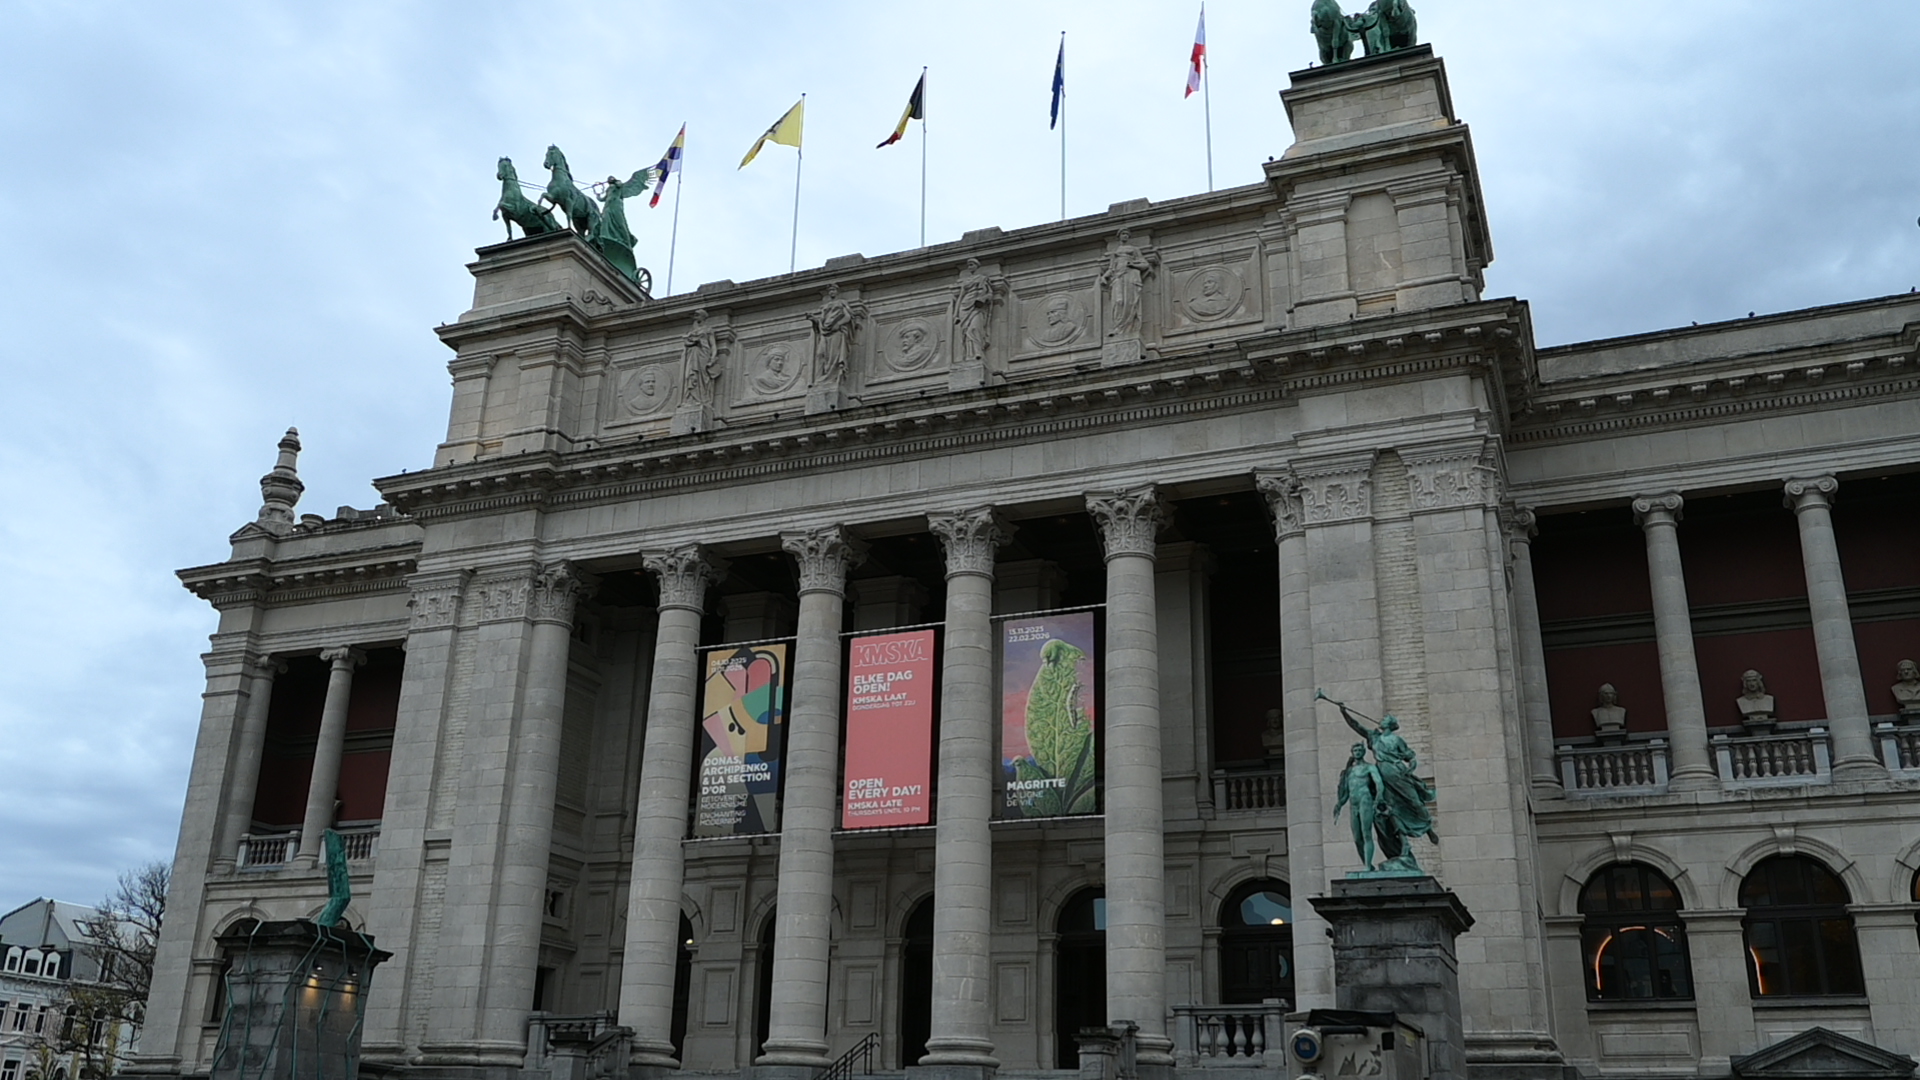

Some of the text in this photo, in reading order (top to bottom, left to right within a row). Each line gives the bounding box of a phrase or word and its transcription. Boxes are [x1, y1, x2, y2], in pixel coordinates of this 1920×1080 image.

[1008, 632, 1050, 642] 22.02.2026
[854, 638, 929, 668] KMSKA
[854, 670, 913, 685] ELKE DAG
[853, 682, 890, 694] OPEN!
[853, 693, 907, 704] KMSKA LAAT
[704, 756, 742, 766] DONAS,
[703, 763, 768, 776] ARCHIPENKO
[702, 772, 771, 785] & LA SECTION
[849, 778, 883, 789] OPEN
[702, 785, 726, 795] D'OR
[1006, 778, 1066, 791] MAGRITTE
[849, 785, 921, 800] EVERY DAY!
[1006, 790, 1044, 800] LA LIGNE
[848, 799, 902, 810] KMSKA LATE
